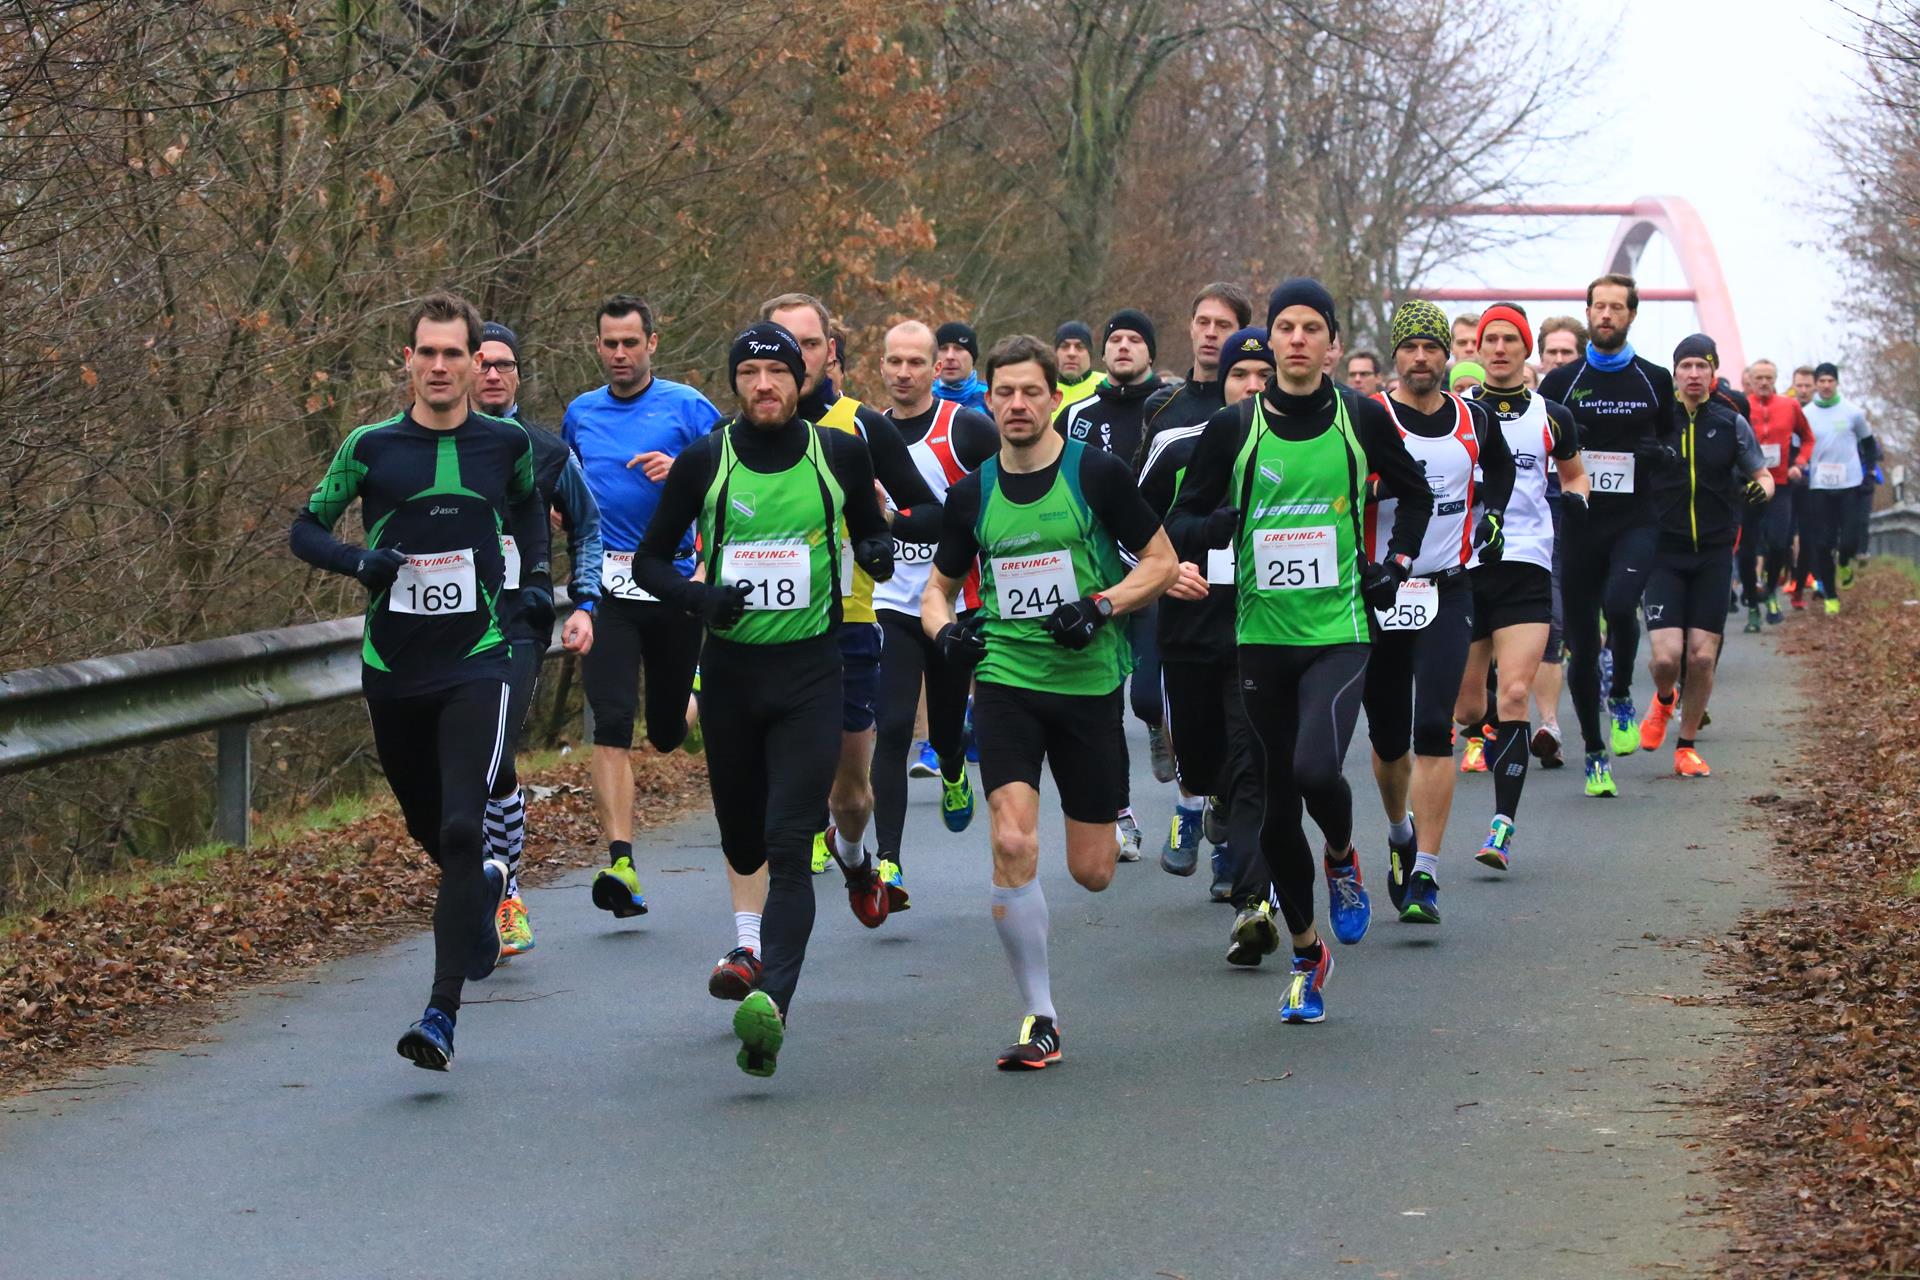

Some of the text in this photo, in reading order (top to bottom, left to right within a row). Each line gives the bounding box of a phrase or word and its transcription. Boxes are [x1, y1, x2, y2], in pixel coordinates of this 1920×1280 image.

[748, 341, 780, 354] Tyron
[1580, 400, 1615, 408] Laufen
[1589, 471, 1625, 490] 167
[1264, 531, 1327, 542] GREVINGA
[734, 550, 799, 559] GREVINGA
[1001, 556, 1061, 571] GREVINGA
[1268, 558, 1320, 586] 251
[407, 582, 462, 612] 169
[735, 578, 796, 607] 218
[1008, 584, 1065, 616] 244
[1383, 604, 1427, 628] 258
